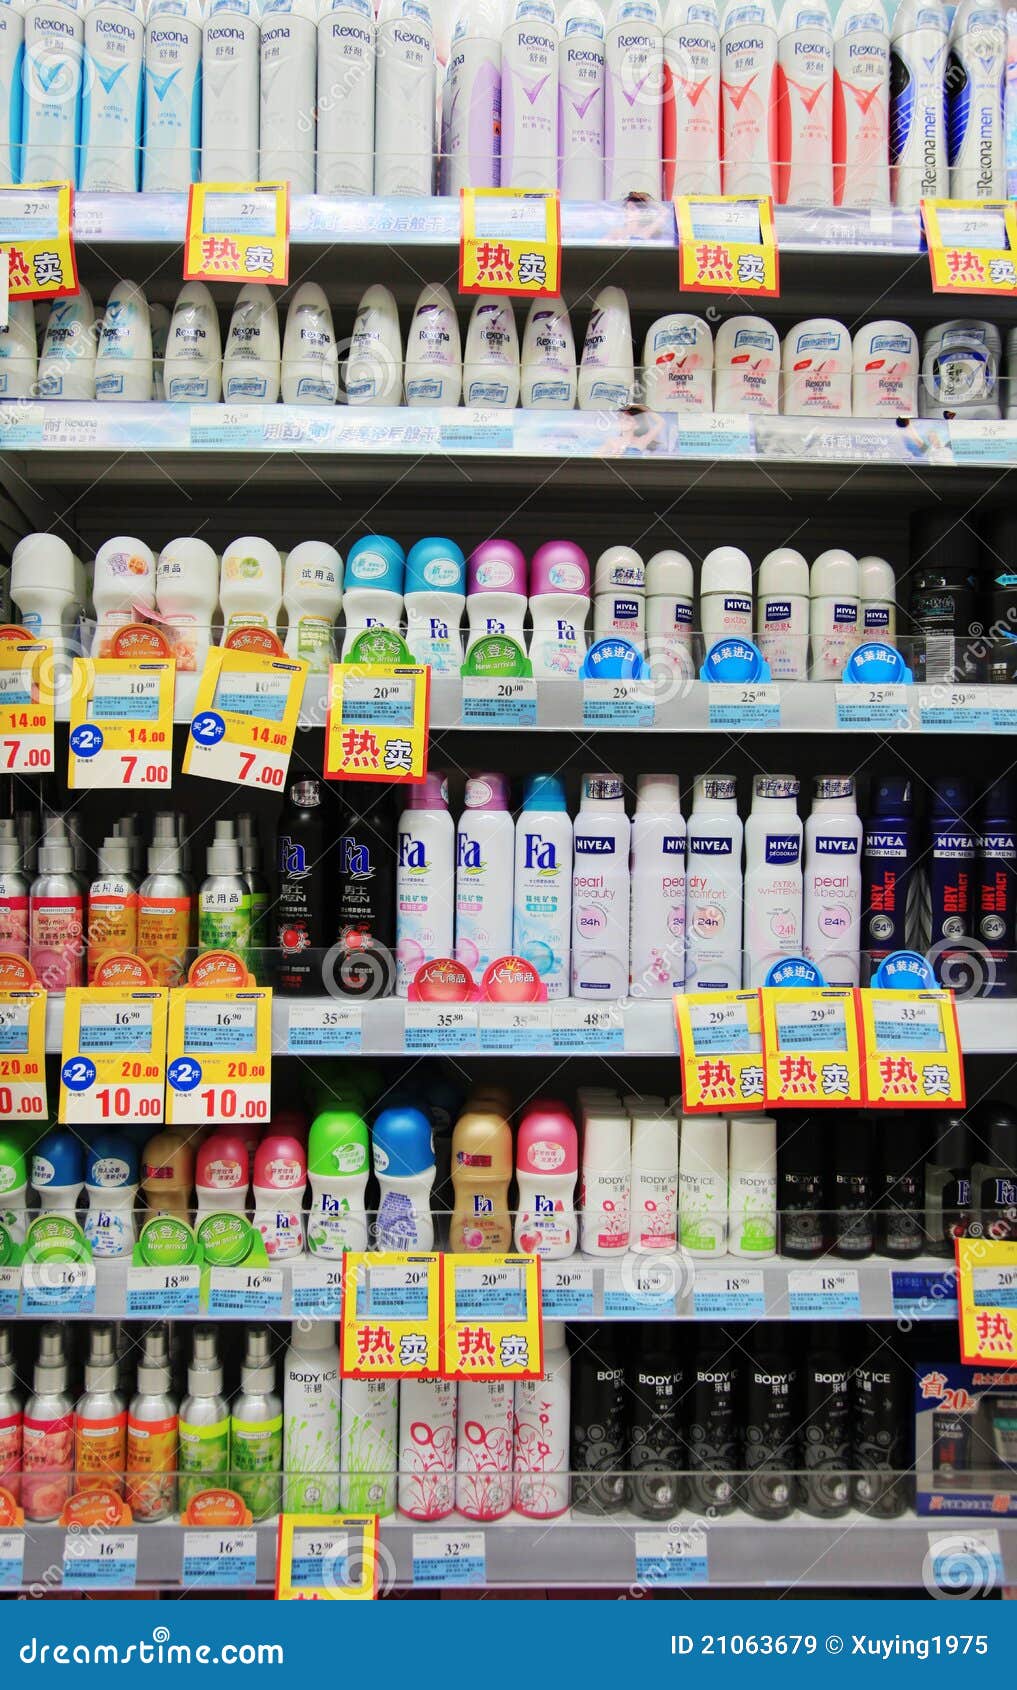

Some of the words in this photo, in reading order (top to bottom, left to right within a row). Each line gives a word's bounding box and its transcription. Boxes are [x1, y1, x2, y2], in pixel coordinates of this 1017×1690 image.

[34, 17, 74, 35] Rexona
[96, 19, 135, 40] Rexona
[151, 31, 188, 44] Rexona
[207, 29, 244, 41] Rexona
[333, 25, 370, 43] Rexona
[394, 29, 430, 50] Rexona
[618, 35, 655, 48] Rexona
[518, 34, 555, 51] Rexona
[679, 37, 716, 52] Rexona
[726, 39, 764, 55] Rexona
[795, 42, 831, 58] Rexona
[568, 49, 604, 65] Rexona
[849, 45, 886, 59] Rexona
[202, 237, 273, 273] 热卖
[476, 242, 546, 285] 热卖
[696, 245, 764, 283] 热卖
[946, 251, 1016, 285] 热卖
[176, 328, 206, 338] Rexona
[419, 330, 450, 341] Rexona
[668, 373, 693, 382] Rexona
[805, 379, 831, 388] Rexona
[302, 569, 335, 582] 试用品
[727, 601, 751, 610] NIVEA
[767, 606, 789, 614] NIVEA
[430, 618, 449, 639] Fa
[558, 621, 576, 640] Fa
[119, 636, 160, 649] 独家产品
[475, 645, 516, 661] 新登场
[591, 647, 635, 663] 原装进口
[711, 648, 754, 664] 原装进口
[854, 648, 896, 665] 原装进口
[476, 662, 491, 671] New
[492, 661, 516, 669] arrival
[129, 681, 155, 695] 10.00
[373, 687, 400, 699] 20.00
[497, 684, 523, 697] 20.00
[742, 691, 766, 703] 25.00
[869, 691, 894, 702] 25.00
[951, 694, 976, 705] 59.00
[10, 713, 47, 728] 14.00
[72, 730, 101, 751] 买2件
[128, 728, 165, 743] 14.00
[251, 726, 287, 746] 14.00
[3, 740, 51, 768] 7.00
[341, 729, 413, 770] 热卖
[120, 756, 168, 784] 7.00
[239, 752, 284, 786] 7.00
[577, 840, 612, 850] NIVEA
[693, 840, 729, 850] NIVEA
[770, 841, 799, 850] NIVEA
[819, 841, 856, 851] NIVEA
[867, 835, 904, 846] NIVEA
[938, 837, 973, 848] NIVEA
[340, 836, 371, 874] Fa
[398, 832, 427, 867] Fa
[457, 832, 482, 867] Fa
[524, 834, 557, 868] Fa
[574, 876, 603, 888] pearl
[689, 876, 707, 889] dry
[814, 875, 849, 889] pearl
[342, 895, 370, 903] MEN
[872, 885, 884, 910] DRY
[884, 872, 896, 911] IMPACT
[944, 885, 956, 912] DRY
[959, 873, 968, 912] IMPACT
[981, 886, 993, 911] DRY
[996, 872, 1007, 911] IMPACT
[205, 894, 240, 905] 试用品
[579, 918, 600, 926] 24h
[698, 918, 719, 926] 24h
[824, 918, 846, 926] 24h
[773, 968, 815, 983] 原装进口
[886, 961, 928, 977] 原装进口
[420, 970, 466, 984] 人气商品
[488, 970, 535, 984] 人气商品
[115, 1013, 140, 1025] 16.90
[216, 1013, 241, 1025] 16.90
[710, 1010, 735, 1023] 29.40
[811, 1008, 836, 1021] 29.40
[1, 1061, 38, 1075] 20.00
[63, 1063, 95, 1081] 买2件
[121, 1060, 159, 1077] 20.00
[169, 1064, 199, 1082] 买2件
[228, 1062, 264, 1077] 20.00
[779, 1056, 849, 1094] 热卖
[880, 1056, 950, 1095] 热卖
[698, 1060, 764, 1099] 热卖
[96, 1088, 161, 1117] 10.00
[201, 1088, 267, 1118] 10.00
[598, 1176, 623, 1185] BODY
[474, 1194, 492, 1216] Fa
[535, 1194, 554, 1217] Fa
[98, 1212, 110, 1227] Fa
[147, 1224, 187, 1243] 新登场
[165, 1275, 189, 1288] 18.80
[247, 1275, 271, 1288] 16.80
[481, 1274, 507, 1286] 20.00
[556, 1274, 581, 1286] 20.00
[725, 1278, 749, 1290] 18.90
[821, 1277, 845, 1289] 18.90
[976, 1312, 1013, 1352] 热
[357, 1325, 428, 1366] 热卖
[458, 1326, 528, 1367] 热卖
[289, 1371, 320, 1384] BODY
[322, 1369, 337, 1381] ICE
[639, 1374, 671, 1386] BODY
[697, 1371, 729, 1383] BODY
[754, 1373, 787, 1385] BODY
[814, 1373, 846, 1383] BODY
[872, 1373, 891, 1383] ICE
[920, 1372, 948, 1398] 省
[99, 1543, 124, 1555] 16.90
[307, 1542, 333, 1555] 32.90
[444, 1542, 470, 1555] 32.90
